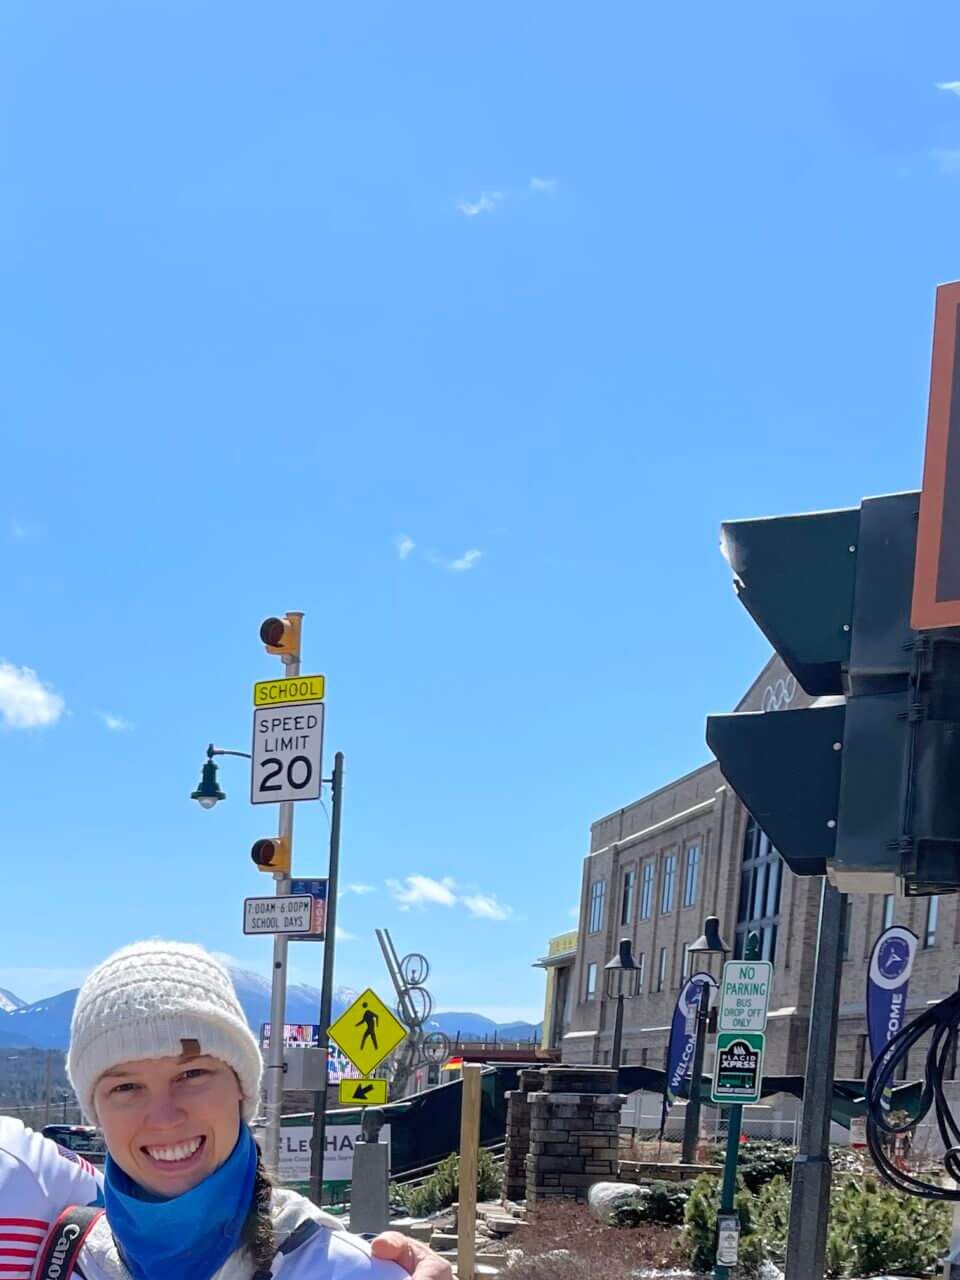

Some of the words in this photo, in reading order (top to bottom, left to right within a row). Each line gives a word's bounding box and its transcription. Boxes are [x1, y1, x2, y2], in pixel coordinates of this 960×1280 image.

[260, 682, 318, 700] SCHOOL
[259, 715, 318, 733] SPEED
[264, 735, 310, 752] LIMIT
[259, 755, 312, 792] 20
[251, 917, 280, 929] SCHOOL
[284, 916, 303, 928] DAYS
[739, 967, 755, 980] NO
[725, 982, 766, 996] PARKING
[736, 998, 752, 1008] BUS
[724, 1008, 745, 1017] DROP
[732, 1018, 752, 1027] ONLY
